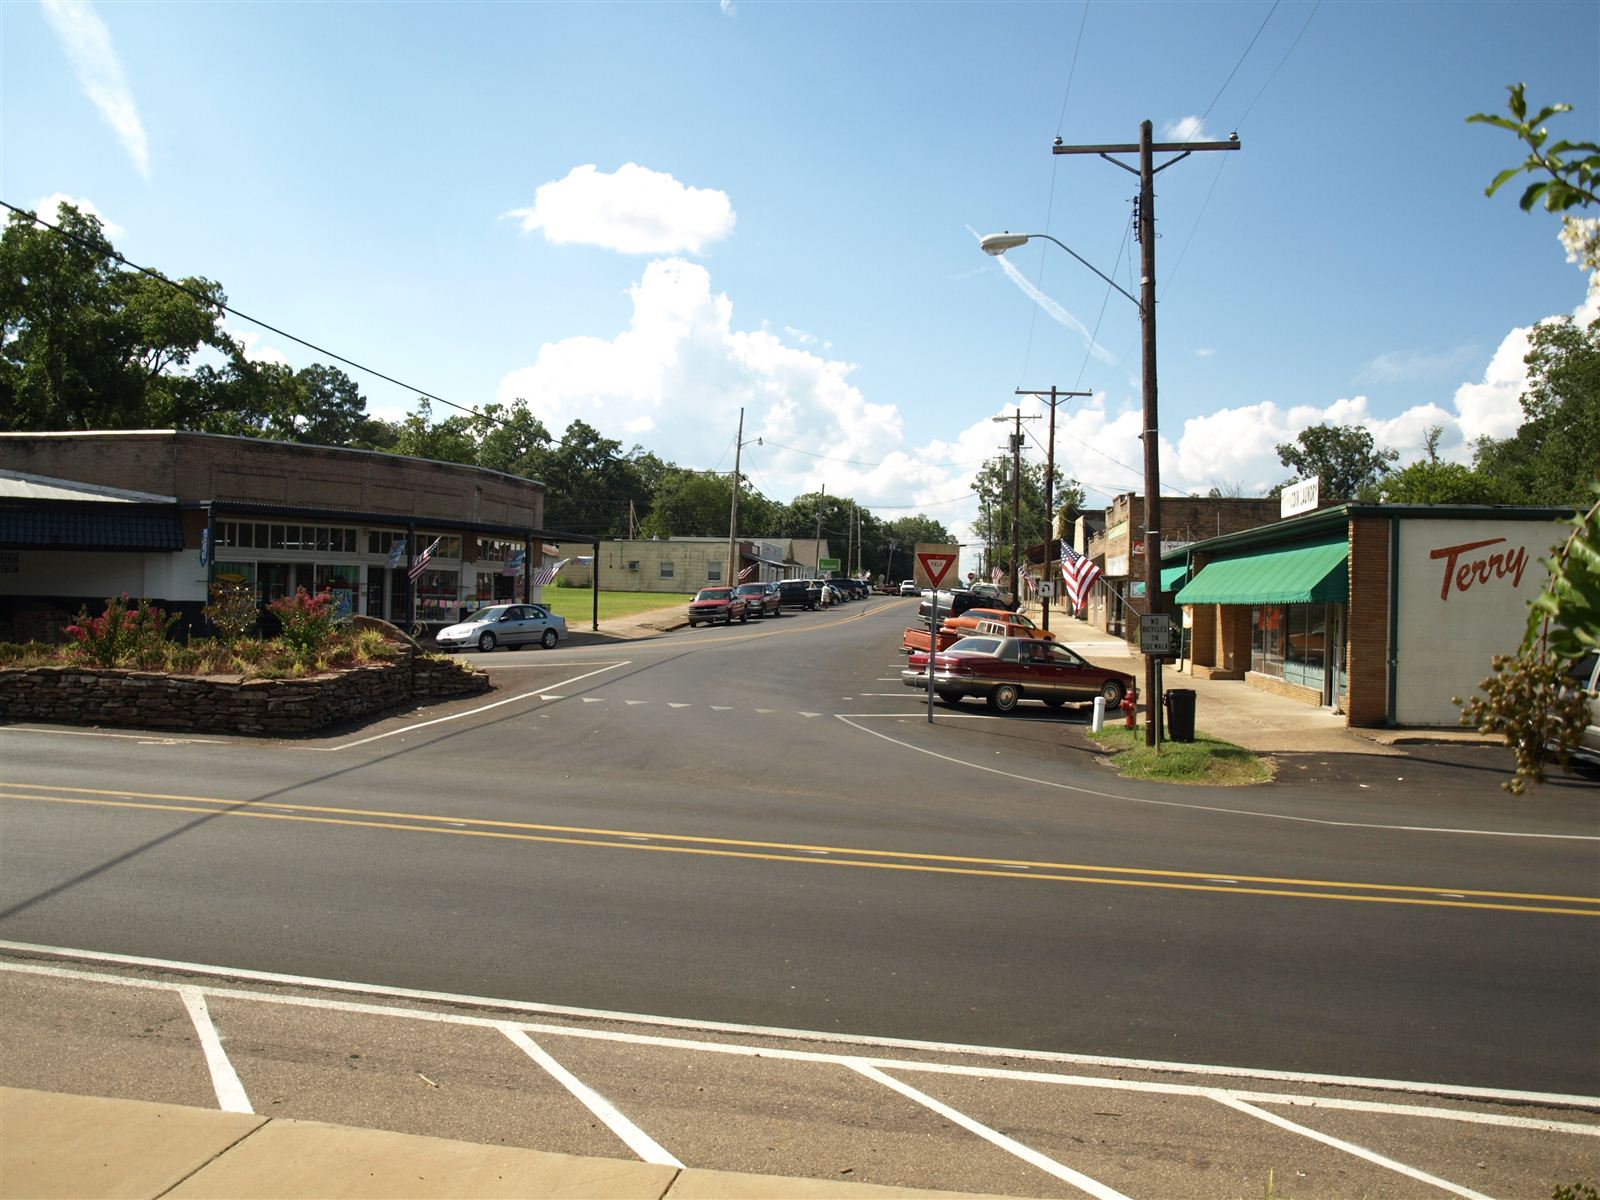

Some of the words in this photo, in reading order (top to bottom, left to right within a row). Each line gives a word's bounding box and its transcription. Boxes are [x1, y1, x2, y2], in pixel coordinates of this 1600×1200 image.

[1430, 537, 1529, 601] Terry
[1151, 617, 1160, 626] NO
[1142, 625, 1167, 633] BICYCLES
[1142, 642, 1168, 650] SIDEWALK
